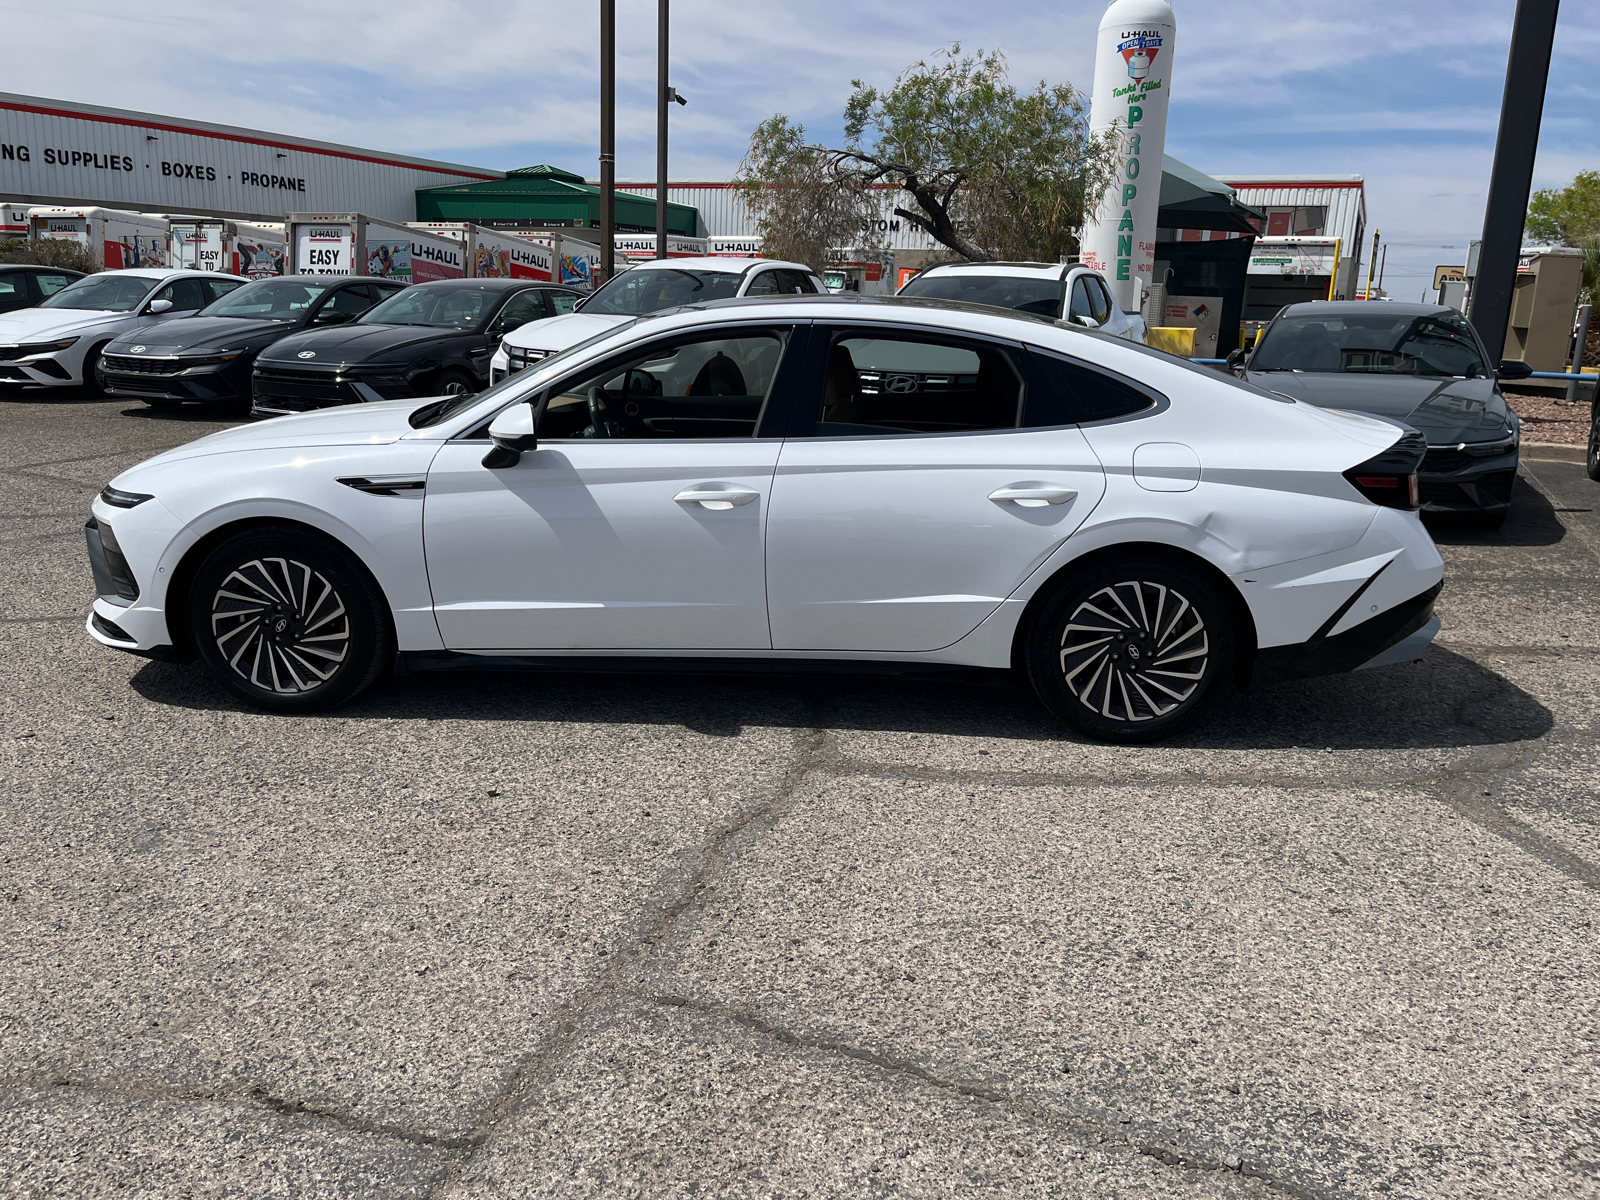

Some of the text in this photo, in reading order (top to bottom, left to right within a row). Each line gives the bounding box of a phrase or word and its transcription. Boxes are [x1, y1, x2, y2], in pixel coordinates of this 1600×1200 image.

[1121, 30, 1161, 39] U-HAUL
[1121, 39, 1139, 50] OPEN
[1112, 78, 1162, 98] Tanks Filled
[1127, 93, 1147, 104] Here
[44, 149, 133, 171] SUPPLIES
[161, 161, 216, 181] BOXES
[241, 171, 306, 192] PROPANE
[1116, 106, 1143, 281] PROPANE
[50, 224, 77, 232] U-HAUL
[310, 230, 341, 238] U-HAUL
[614, 241, 655, 250] U-HAUL
[676, 243, 701, 253] U-HAUL
[714, 243, 759, 252] U-HAUL
[200, 250, 219, 260] EASY
[309, 249, 340, 266] EASY
[411, 242, 460, 267] U-HAUL
[511, 248, 550, 270] U-HAUL
[205, 261, 214, 271] TO
